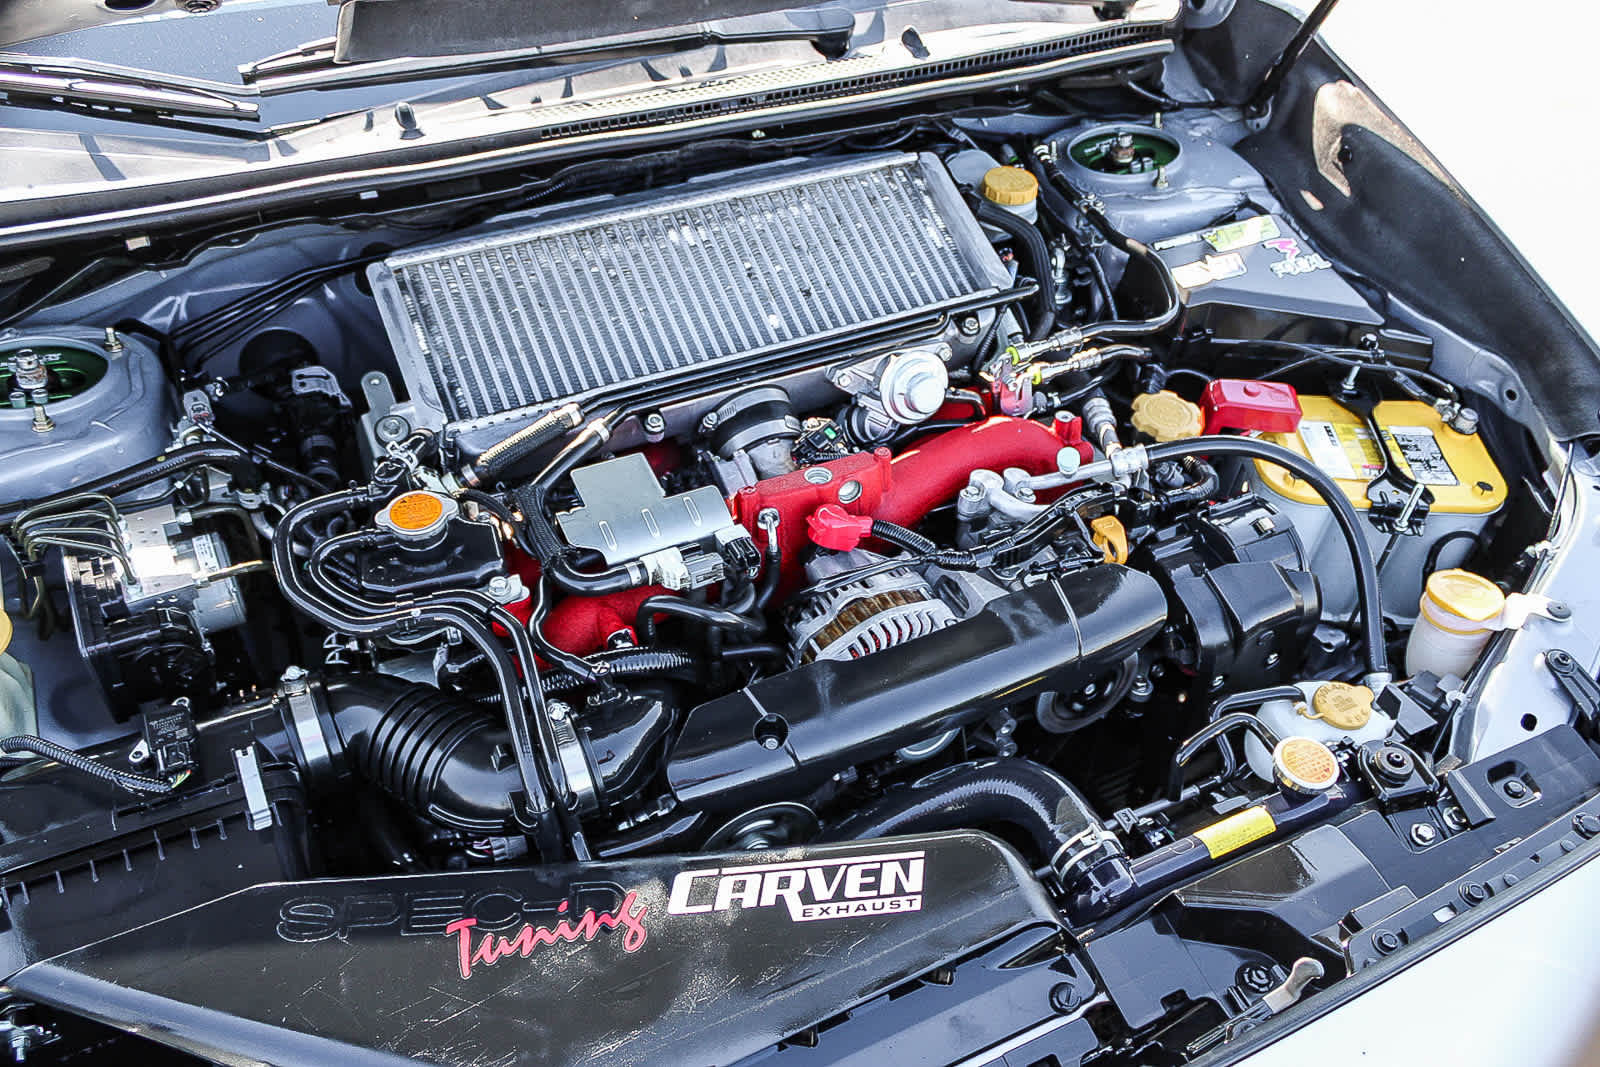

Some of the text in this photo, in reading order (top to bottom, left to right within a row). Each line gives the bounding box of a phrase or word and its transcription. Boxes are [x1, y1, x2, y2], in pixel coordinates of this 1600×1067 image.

[667, 850, 926, 918] CARVEN
[802, 898, 919, 919] EXHAUST
[445, 891, 649, 980] Tuning
